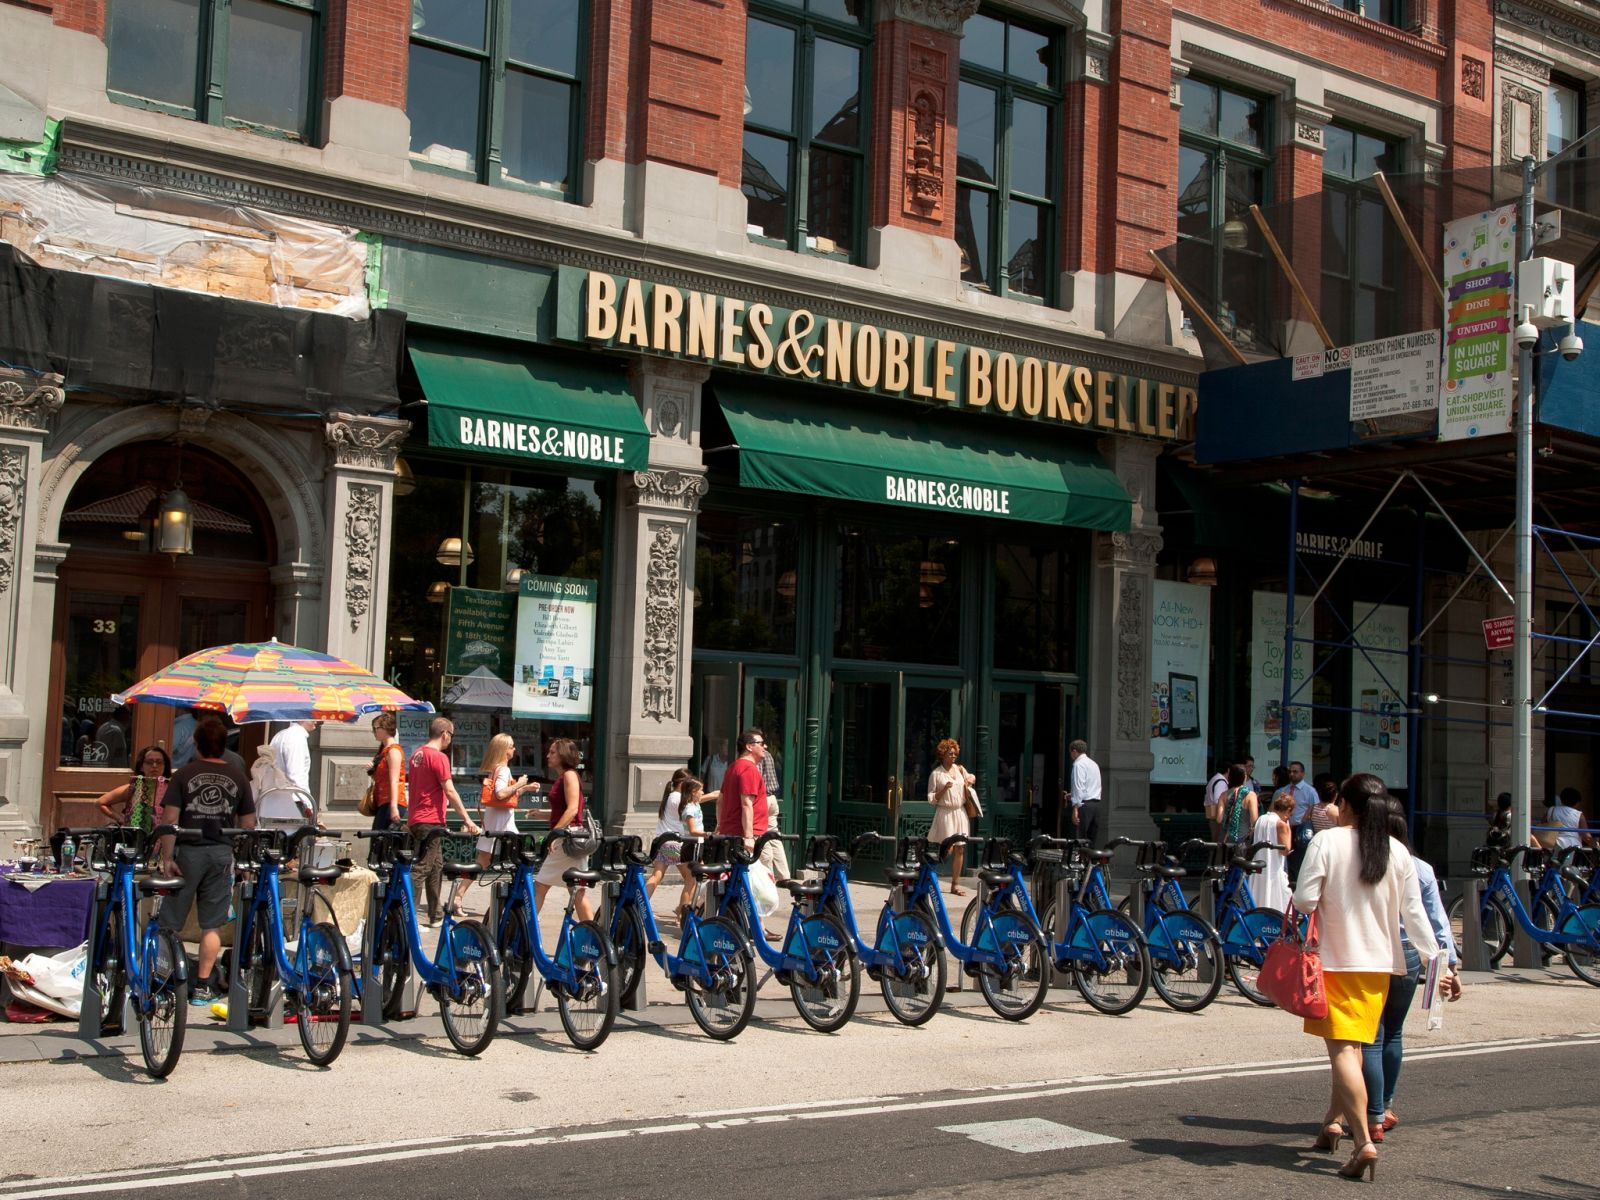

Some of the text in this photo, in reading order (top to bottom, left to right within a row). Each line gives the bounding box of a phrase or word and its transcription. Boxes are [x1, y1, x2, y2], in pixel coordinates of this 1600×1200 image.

[1465, 277, 1491, 290] SHOP
[1466, 299, 1490, 311] DINE
[1457, 320, 1498, 336] UNWIND
[1354, 341, 1385, 358] EMERGENCY
[1387, 338, 1404, 352] PHONE
[1454, 340, 1500, 359] IN UNION
[1325, 350, 1340, 364] NO
[1456, 354, 1498, 372] SQUARE
[1324, 360, 1350, 371] SMOKING
[1446, 405, 1470, 417] UNION
[527, 580, 588, 596] COMING SOON
[464, 596, 502, 606] Textbooks
[1160, 601, 1194, 614] All-New
[454, 606, 487, 618] available
[93, 620, 116, 634] 33
[458, 619, 504, 630] Fifth Avenue
[465, 631, 481, 640] 18th
[483, 633, 504, 642] Street
[466, 644, 494, 654] location
[1264, 640, 1302, 663] Toy &
[1262, 661, 1304, 680] Gaes
[80, 697, 102, 712] GSG
[502, 721, 538, 732] Events
[1162, 753, 1184, 765] nook
[1370, 760, 1388, 770] nook
